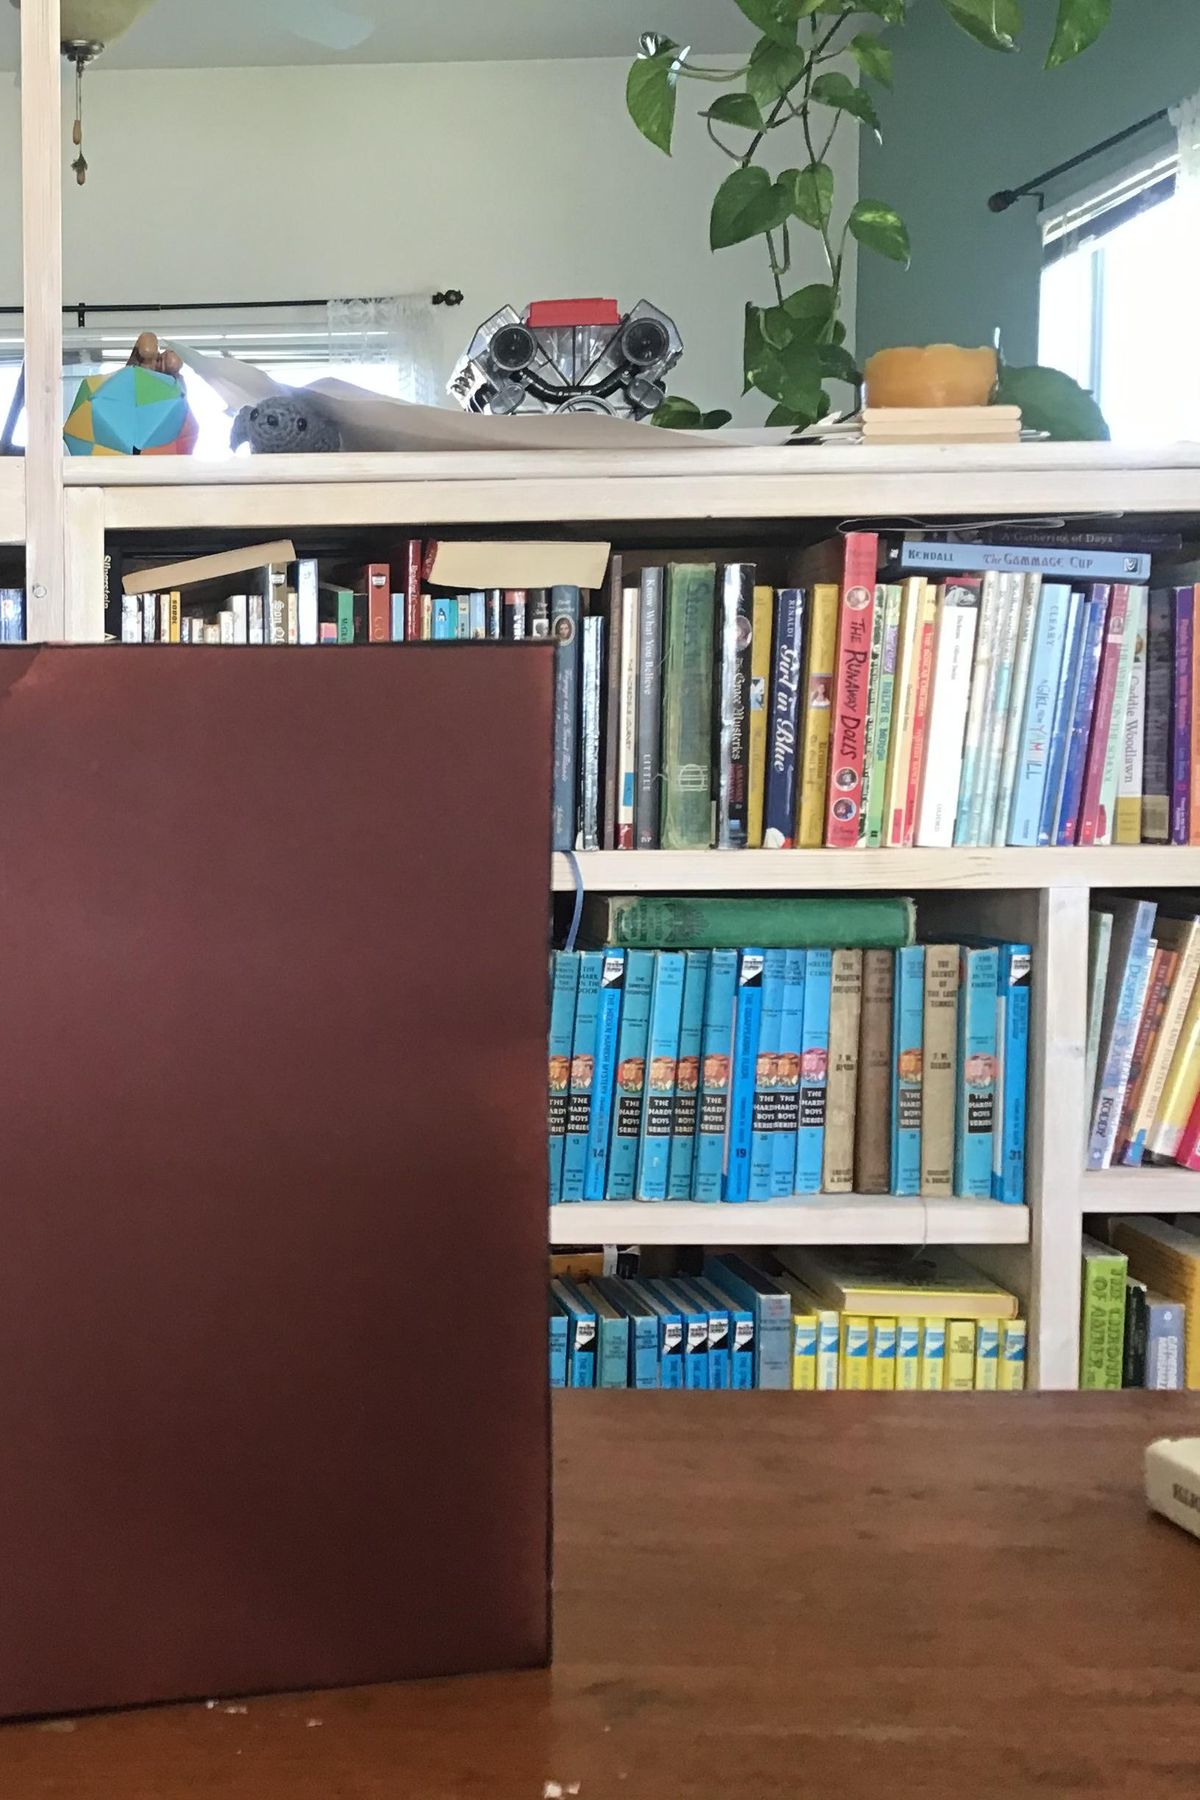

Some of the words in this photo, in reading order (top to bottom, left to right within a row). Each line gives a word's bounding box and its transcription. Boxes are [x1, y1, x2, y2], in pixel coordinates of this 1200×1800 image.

[1013, 534, 1068, 546] Gathering
[1071, 534, 1083, 543] of
[1085, 534, 1113, 546] Days
[908, 550, 955, 562] KENDALL
[983, 554, 1002, 564] The
[1004, 556, 1066, 568] GAMMAGE
[1070, 556, 1094, 569] CUP
[646, 579, 655, 607] Know
[645, 610, 654, 635] What
[787, 599, 795, 638] RINALDI
[955, 615, 963, 639] Dickens
[1046, 605, 1059, 646] CLEARY
[850, 619, 865, 645] THE
[645, 639, 654, 657] You
[644, 661, 654, 695] Believe
[778, 645, 798, 691] Girl
[844, 649, 868, 712] RUNAWAY
[776, 692, 792, 711] in
[1035, 685, 1050, 709] GIRL
[1126, 676, 1140, 716] Caddie
[731, 705, 745, 760] Mysteries
[774, 718, 794, 772] Blue
[841, 715, 860, 760] DOLLS
[1124, 720, 1138, 783] Woodlawn
[642, 754, 651, 792] LITTLE
[607, 993, 615, 1005] THE
[1175, 1000, 1189, 1025] POEMS
[1168, 1028, 1182, 1046] AND
[601, 1064, 609, 1095] MYSTERY
[1154, 1048, 1175, 1093] FOURTEEN
[1096, 1097, 1114, 1138] RODDY
[1146, 1095, 1157, 1119] MORE
[593, 1149, 604, 1158] 14
[736, 1149, 747, 1158] 19
[1009, 1151, 1021, 1160] 31
[1092, 1277, 1107, 1300] OF
[1088, 1305, 1106, 1369] AMBER
